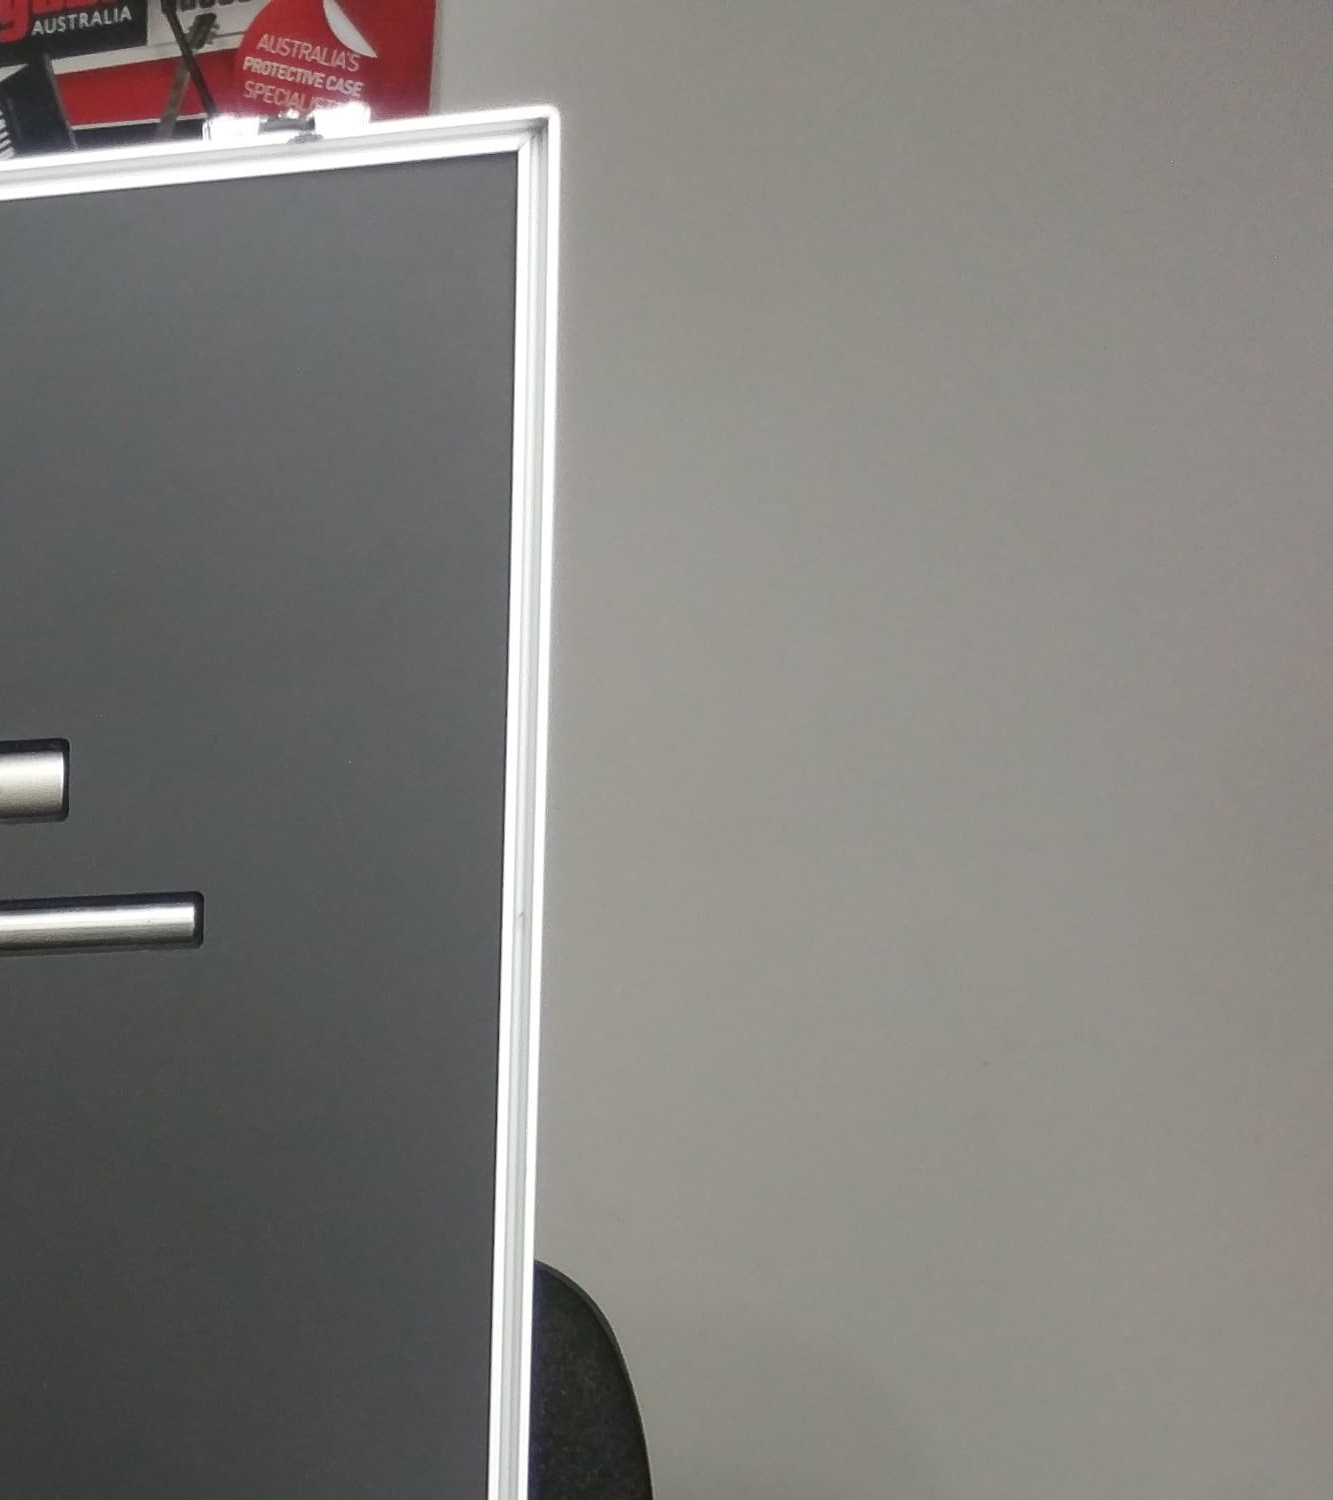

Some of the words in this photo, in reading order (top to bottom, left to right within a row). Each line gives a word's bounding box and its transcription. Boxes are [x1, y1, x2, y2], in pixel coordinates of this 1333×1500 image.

[31, 6, 132, 36] AUSTRALIA
[256, 33, 362, 72] AUSTRALIA'S
[243, 56, 326, 88] PROTECTIVE
[325, 76, 365, 97] CASE
